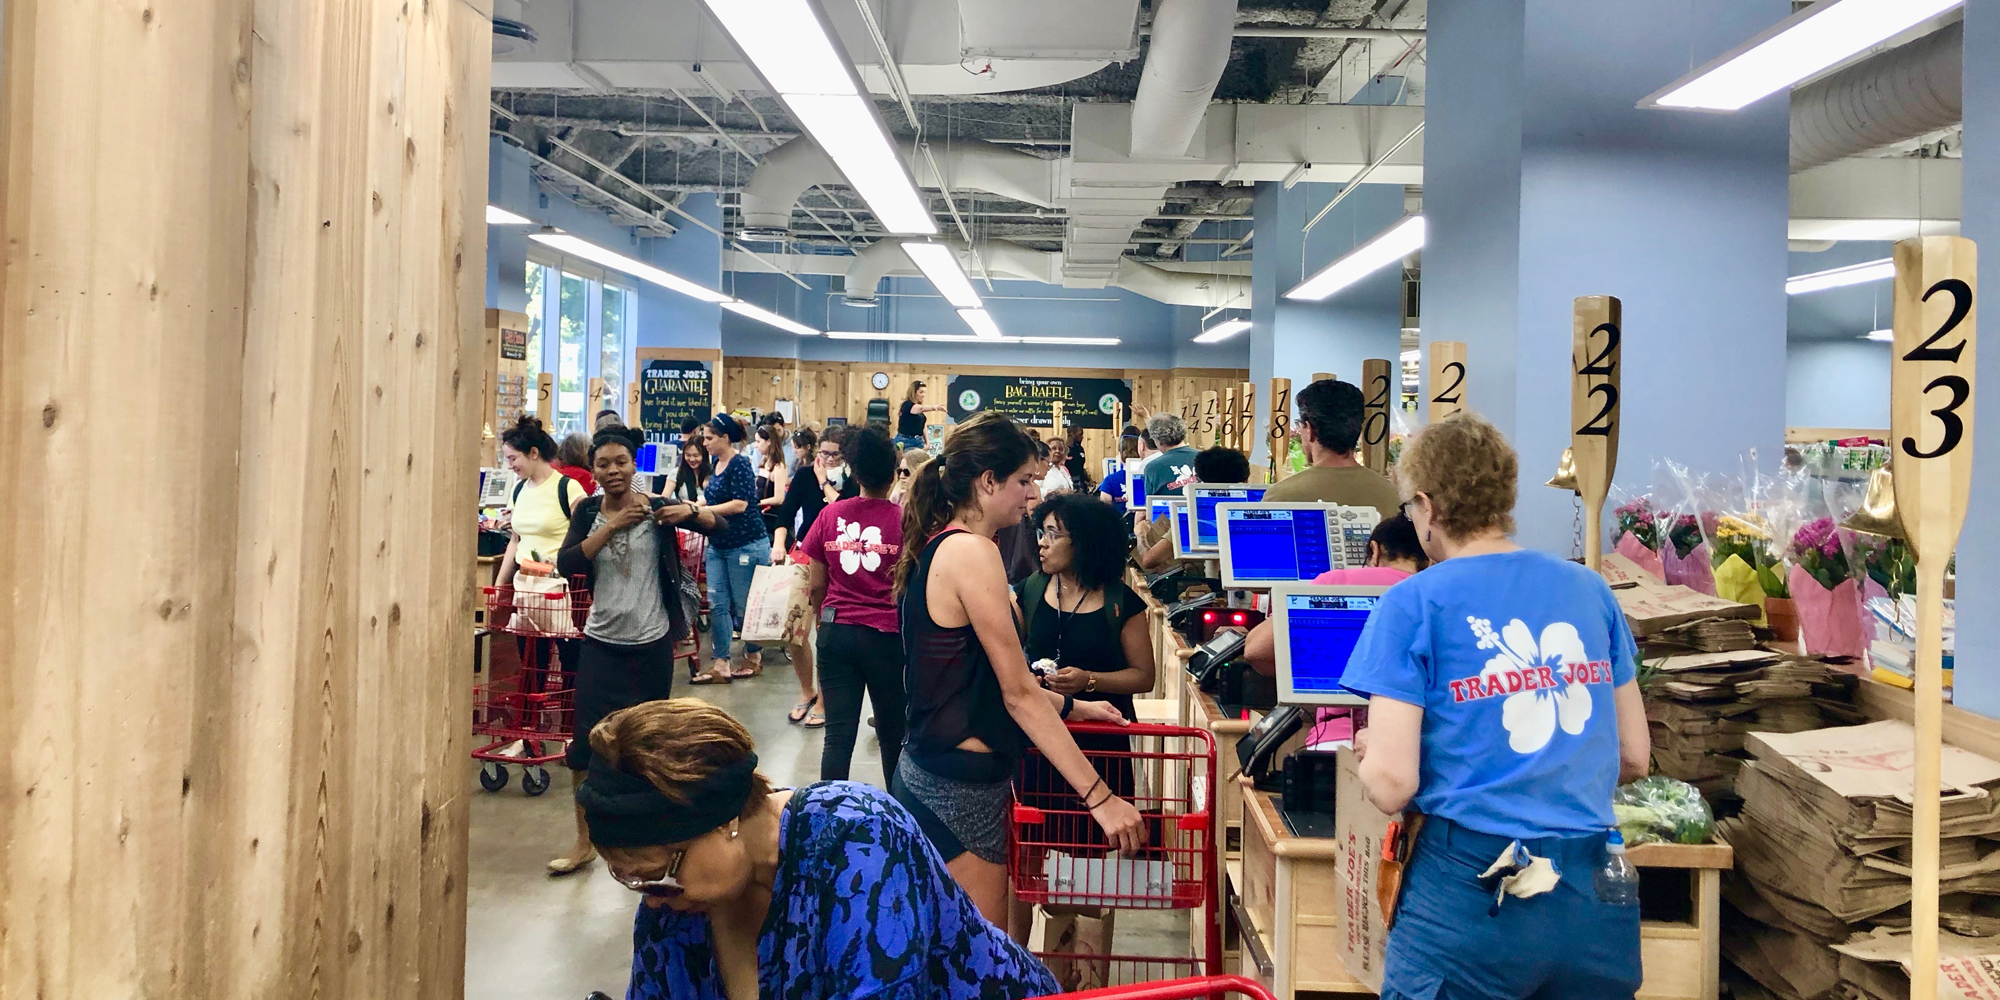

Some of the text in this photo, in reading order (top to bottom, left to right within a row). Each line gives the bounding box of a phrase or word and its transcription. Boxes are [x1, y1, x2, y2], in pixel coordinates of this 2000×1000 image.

[646, 369, 707, 379] TRADER JOE'S
[1902, 278, 1973, 459] 23
[644, 378, 708, 396] GUARANTEE
[1019, 377, 1035, 386] bring
[1576, 323, 1620, 436] 22
[538, 383, 551, 401] 5
[590, 386, 602, 402] 4
[629, 389, 640, 405] 3
[1005, 385, 1073, 399] BAG RAFFLE
[1054, 406, 1062, 418] 2
[1115, 408, 1122, 419] 1
[1202, 398, 1216, 434] 15
[1222, 397, 1235, 435] 16
[1239, 393, 1253, 435] 17
[1271, 389, 1289, 438] 18
[645, 418, 662, 431] bring
[1449, 660, 1611, 703] TRADER JOE'S
[1346, 831, 1357, 953] TRADER JOE'S
